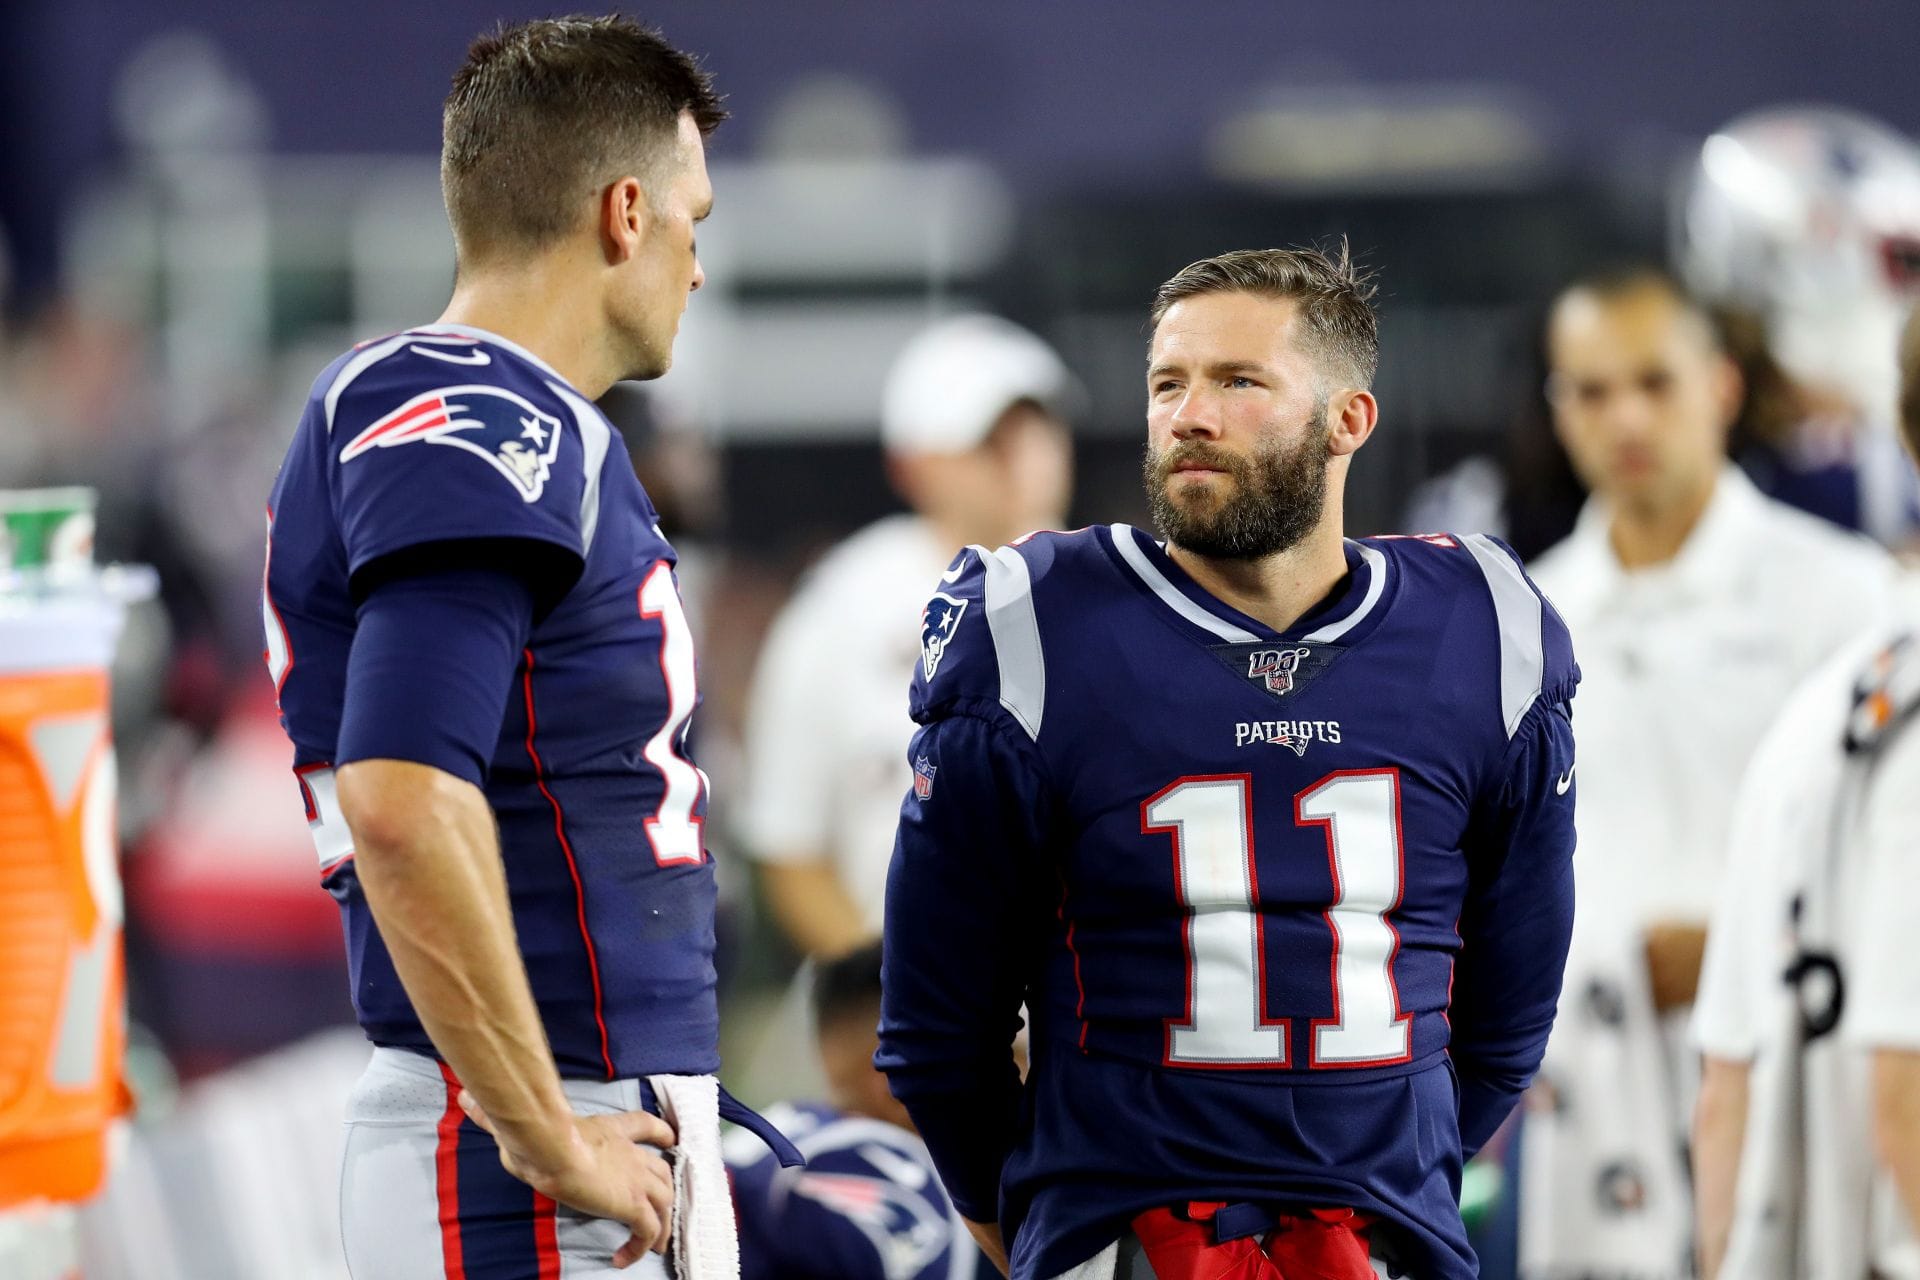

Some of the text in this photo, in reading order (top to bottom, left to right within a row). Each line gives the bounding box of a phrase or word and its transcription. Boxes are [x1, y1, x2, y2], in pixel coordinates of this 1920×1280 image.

[638, 559, 710, 868] 1
[1235, 720, 1341, 747] PATRIOTS
[1248, 649, 1300, 677] 100
[1140, 767, 1414, 1069] 11
